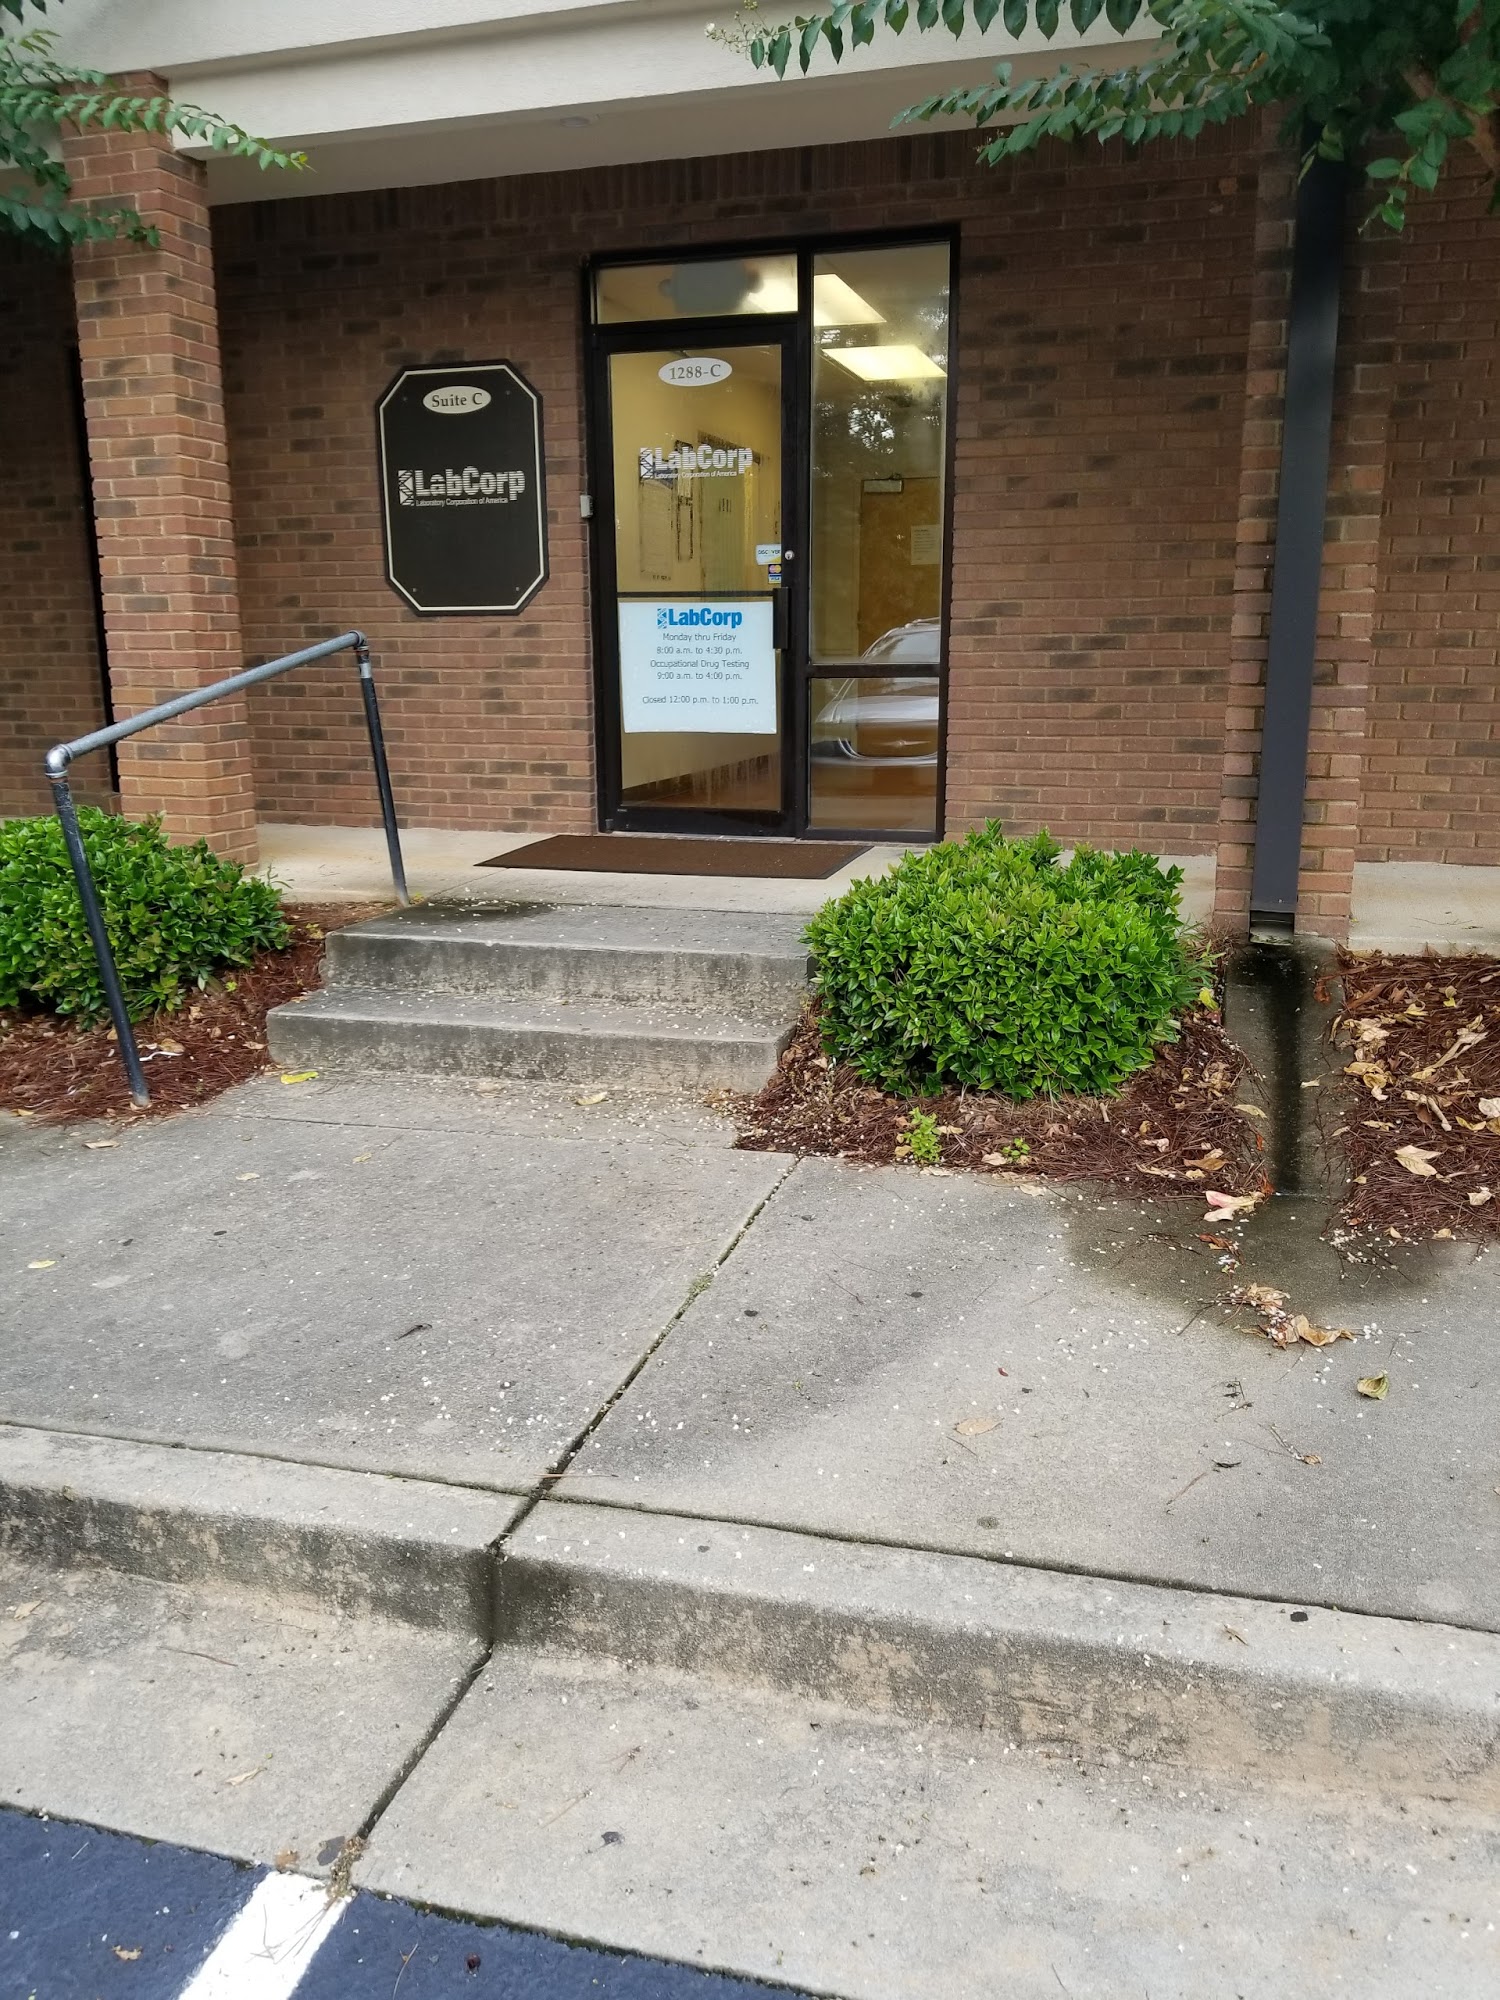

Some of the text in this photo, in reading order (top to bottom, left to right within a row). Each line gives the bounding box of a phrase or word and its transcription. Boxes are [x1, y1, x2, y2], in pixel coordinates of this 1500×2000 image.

[669, 364, 721, 380] 1288-C
[431, 392, 483, 408] Suite C
[654, 443, 753, 474] LabCorp
[414, 465, 525, 501] LabCorp
[415, 499, 446, 508] Laboratory
[445, 498, 479, 507] Corporation
[668, 608, 743, 629] LabCorp
[662, 633, 736, 642] Monday thru Friday
[656, 646, 674, 655] 8:00
[705, 646, 723, 655] 4:30
[725, 647, 743, 655] p.m.
[650, 659, 750, 669] Occupational Drug Testing
[656, 672, 674, 680] 9:00
[695, 672, 704, 680] to
[705, 672, 723, 680] 4:00
[725, 673, 743, 681] p.m.
[642, 695, 759, 705] Closed 12:00 p.m. to 1:00 p.m.
